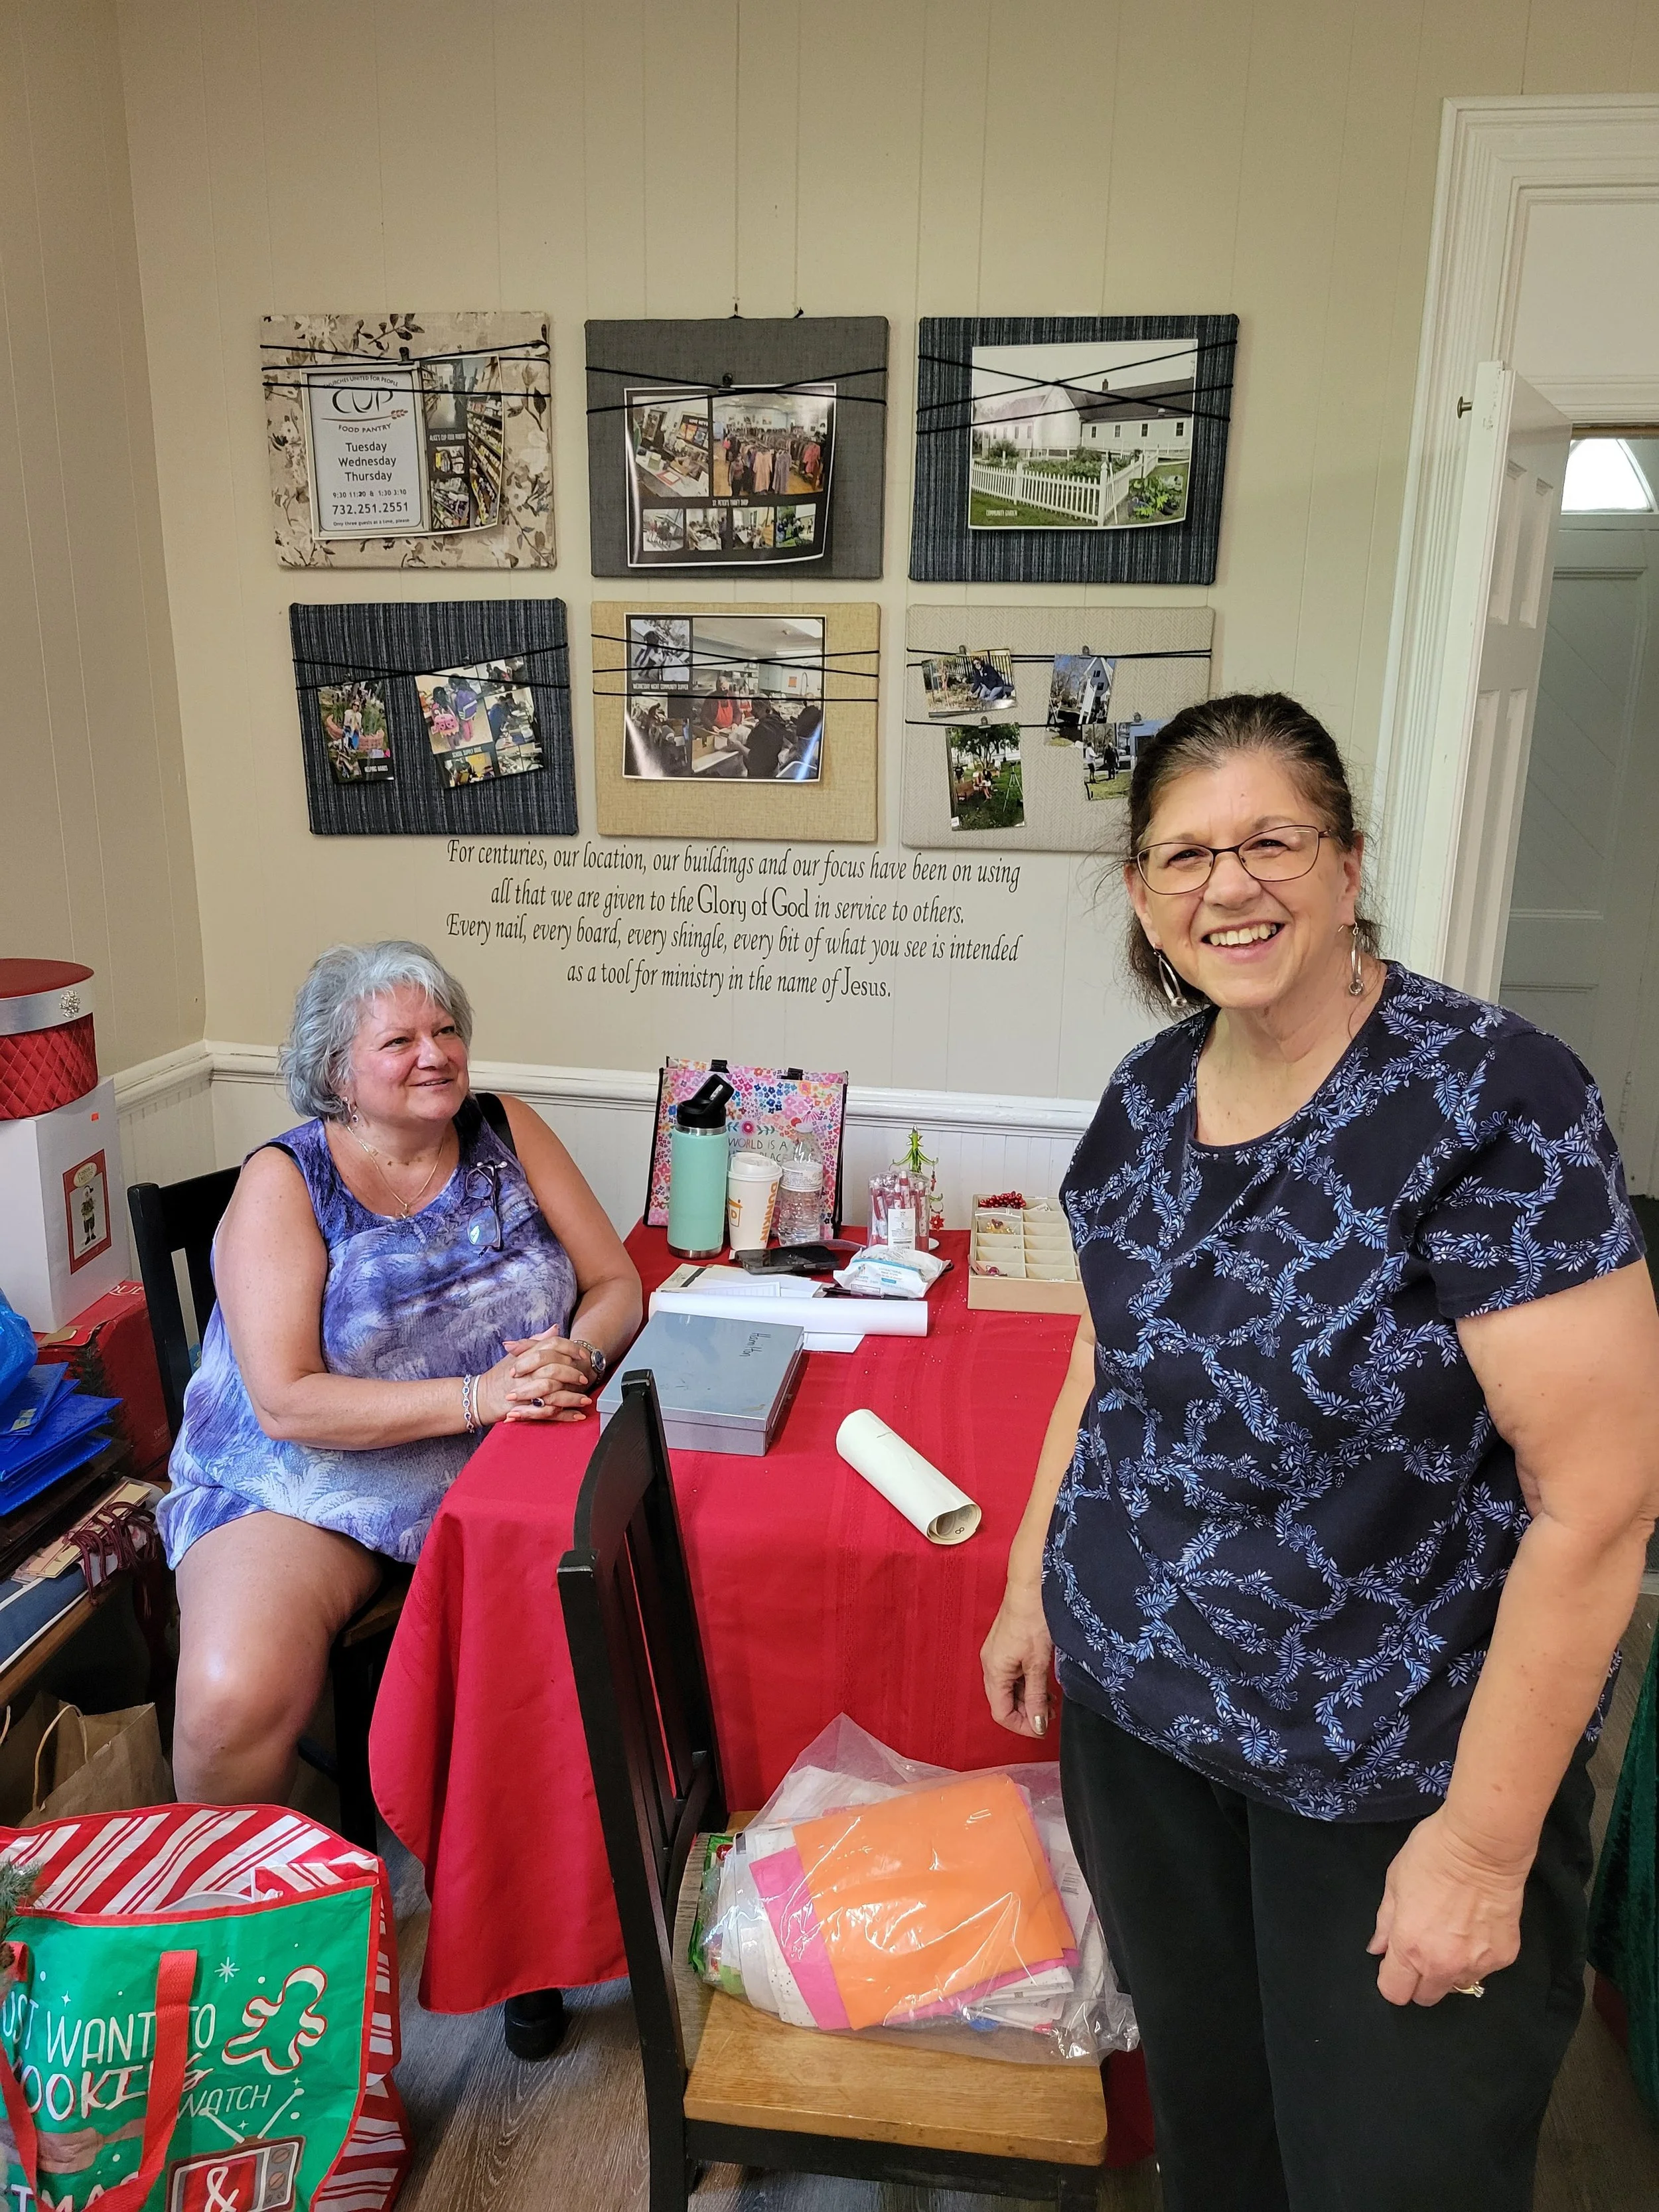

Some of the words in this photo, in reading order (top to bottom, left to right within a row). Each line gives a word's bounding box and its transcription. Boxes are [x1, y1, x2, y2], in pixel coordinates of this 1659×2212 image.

[381, 376, 399, 387] PEOPLE
[332, 386, 394, 413] CUP
[338, 424, 360, 433] FOOD
[362, 423, 392, 433] PANTRY
[345, 441, 388, 453] Tuesday
[338, 455, 397, 467] Wednesday
[344, 470, 392, 482] Thursday
[332, 502, 408, 515] 732.251.2551
[448, 840, 474, 862] For
[478, 842, 547, 869] centuries,
[554, 850, 579, 867] our
[583, 841, 646, 875] location,
[654, 854, 680, 871] our
[684, 845, 754, 883] buildings
[759, 848, 791, 875] and
[793, 859, 820, 876] our
[819, 849, 865, 885] focus
[870, 851, 906, 879] have
[913, 852, 947, 881] been
[953, 865, 972, 881] on
[978, 858, 1020, 893] using
[492, 877, 513, 903] all
[516, 879, 546, 905] that
[551, 890, 572, 907] we
[577, 891, 599, 908] are
[603, 885, 644, 918] given
[650, 891, 664, 911] to
[671, 886, 693, 912] the
[697, 884, 746, 922] Glory
[752, 887, 768, 916] of
[772, 887, 809, 917] God
[815, 895, 830, 918] in
[835, 896, 887, 921] service
[893, 901, 907, 921] to
[913, 895, 964, 923] others.
[447, 913, 490, 945] Every
[496, 913, 527, 944] nail,
[534, 924, 571, 950] every
[577, 916, 621, 948] board,
[628, 929, 666, 954] every
[672, 921, 727, 957] shingle,
[734, 934, 773, 960] every
[779, 925, 800, 952] bit
[805, 927, 824, 962] of
[826, 928, 866, 955] what
[869, 940, 899, 964] you
[904, 941, 926, 958] see
[932, 934, 945, 958] is
[950, 934, 1023, 961] intended
[567, 966, 583, 982] as
[588, 966, 596, 982] a
[601, 958, 634, 984] tool
[630, 959, 658, 993] for
[662, 964, 723, 997] ministry
[729, 966, 743, 990] in
[749, 965, 772, 991] the
[777, 976, 817, 993] name
[822, 968, 841, 1003] of
[841, 966, 890, 997] Jesus.
[728, 1138, 763, 1149] WORLD
[768, 1140, 775, 1149] IS
[779, 1141, 788, 1151] A
[2, 1991, 39, 2050] UST
[47, 2010, 157, 2068] WANT
[189, 2003, 216, 2049] O
